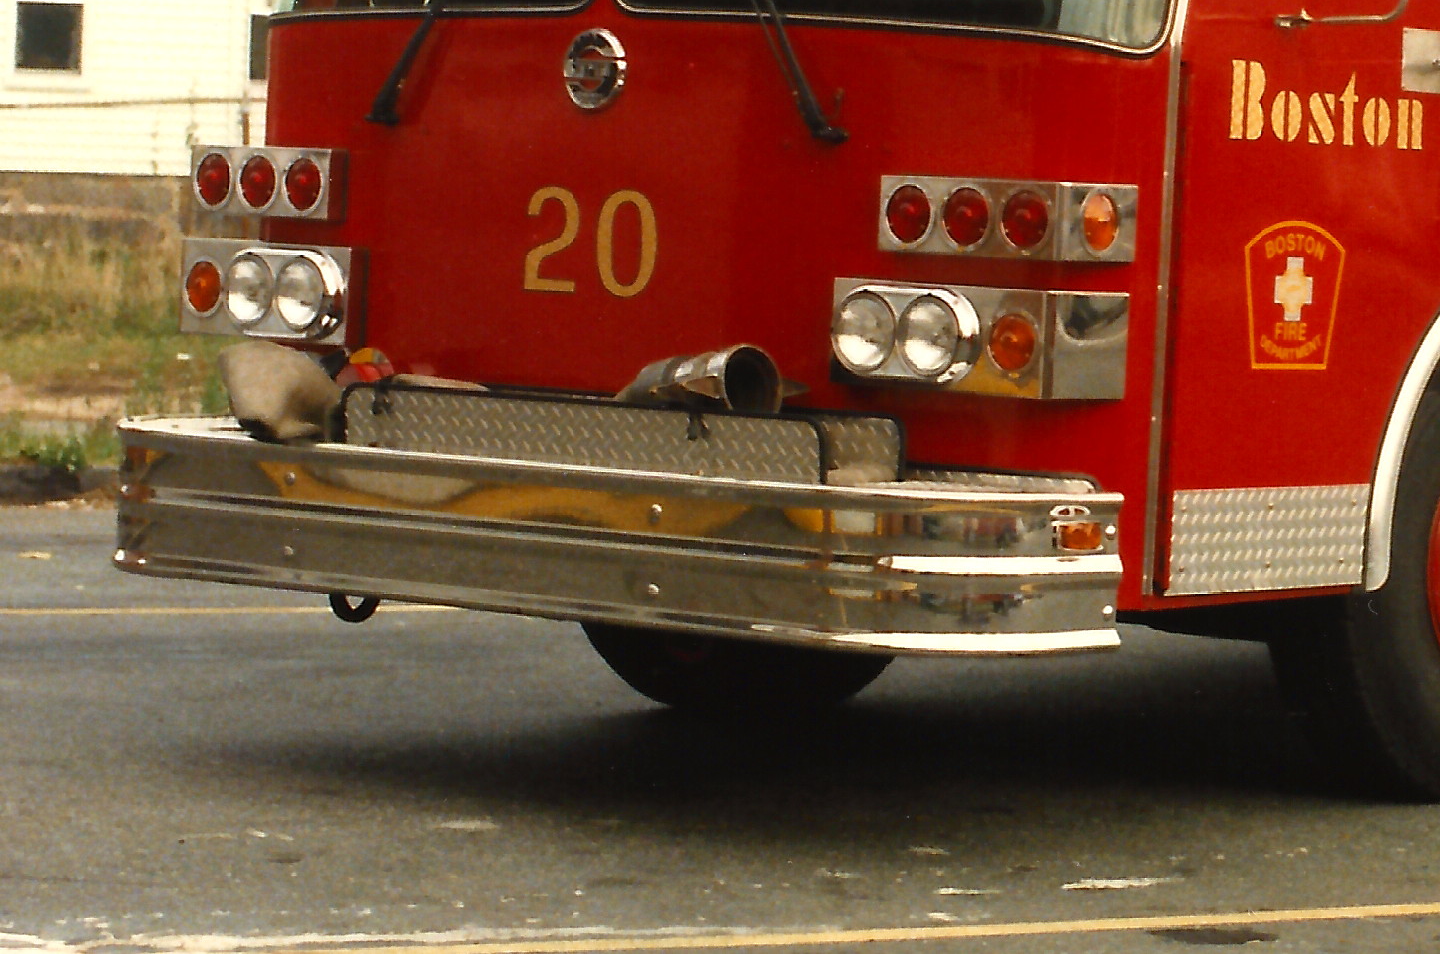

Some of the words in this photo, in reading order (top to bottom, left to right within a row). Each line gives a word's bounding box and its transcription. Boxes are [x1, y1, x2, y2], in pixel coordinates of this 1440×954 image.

[1229, 59, 1425, 150] Boston
[523, 186, 658, 297] 20
[1264, 233, 1327, 261] BOSTON
[1274, 322, 1308, 341] FIRE
